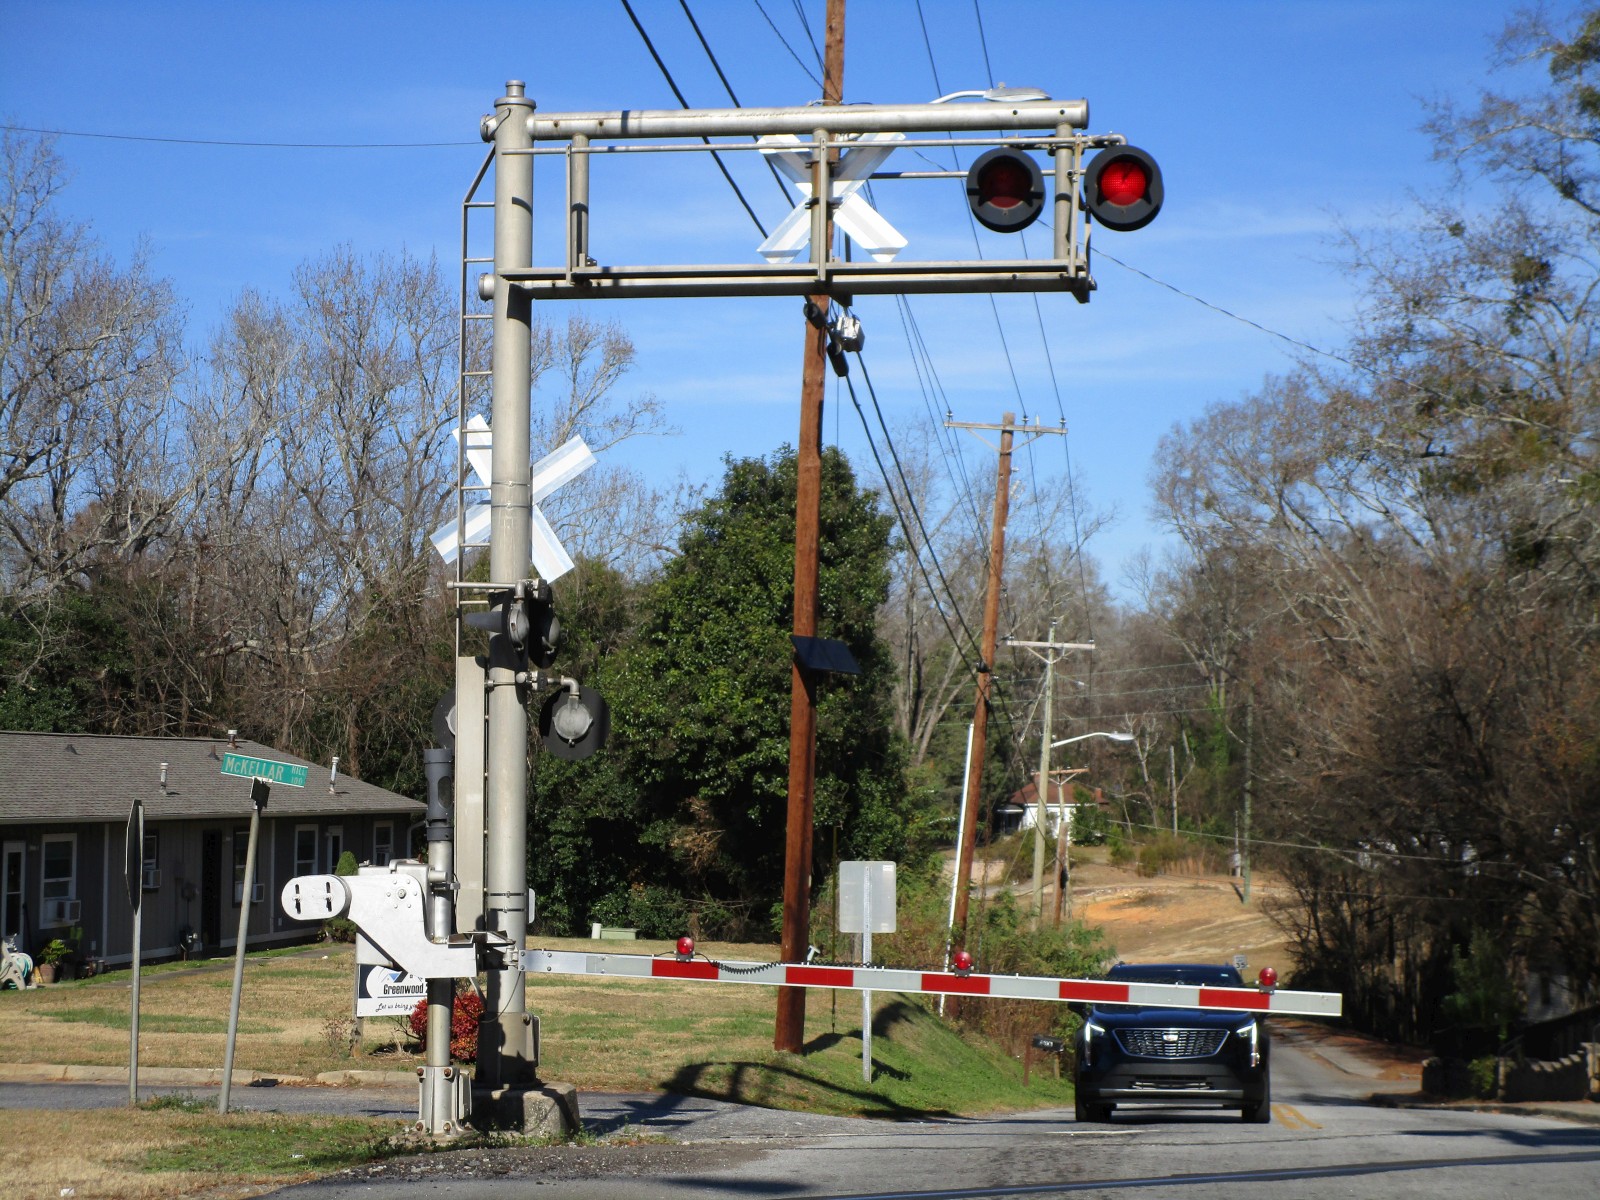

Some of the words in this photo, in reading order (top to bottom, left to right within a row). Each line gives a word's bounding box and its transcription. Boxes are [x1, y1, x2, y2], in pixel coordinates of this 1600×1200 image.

[225, 756, 284, 781] McKELLAR
[1235, 961, 1246, 969] 35
[383, 983, 424, 995] Greenwood
[375, 1003, 386, 1012] Let
